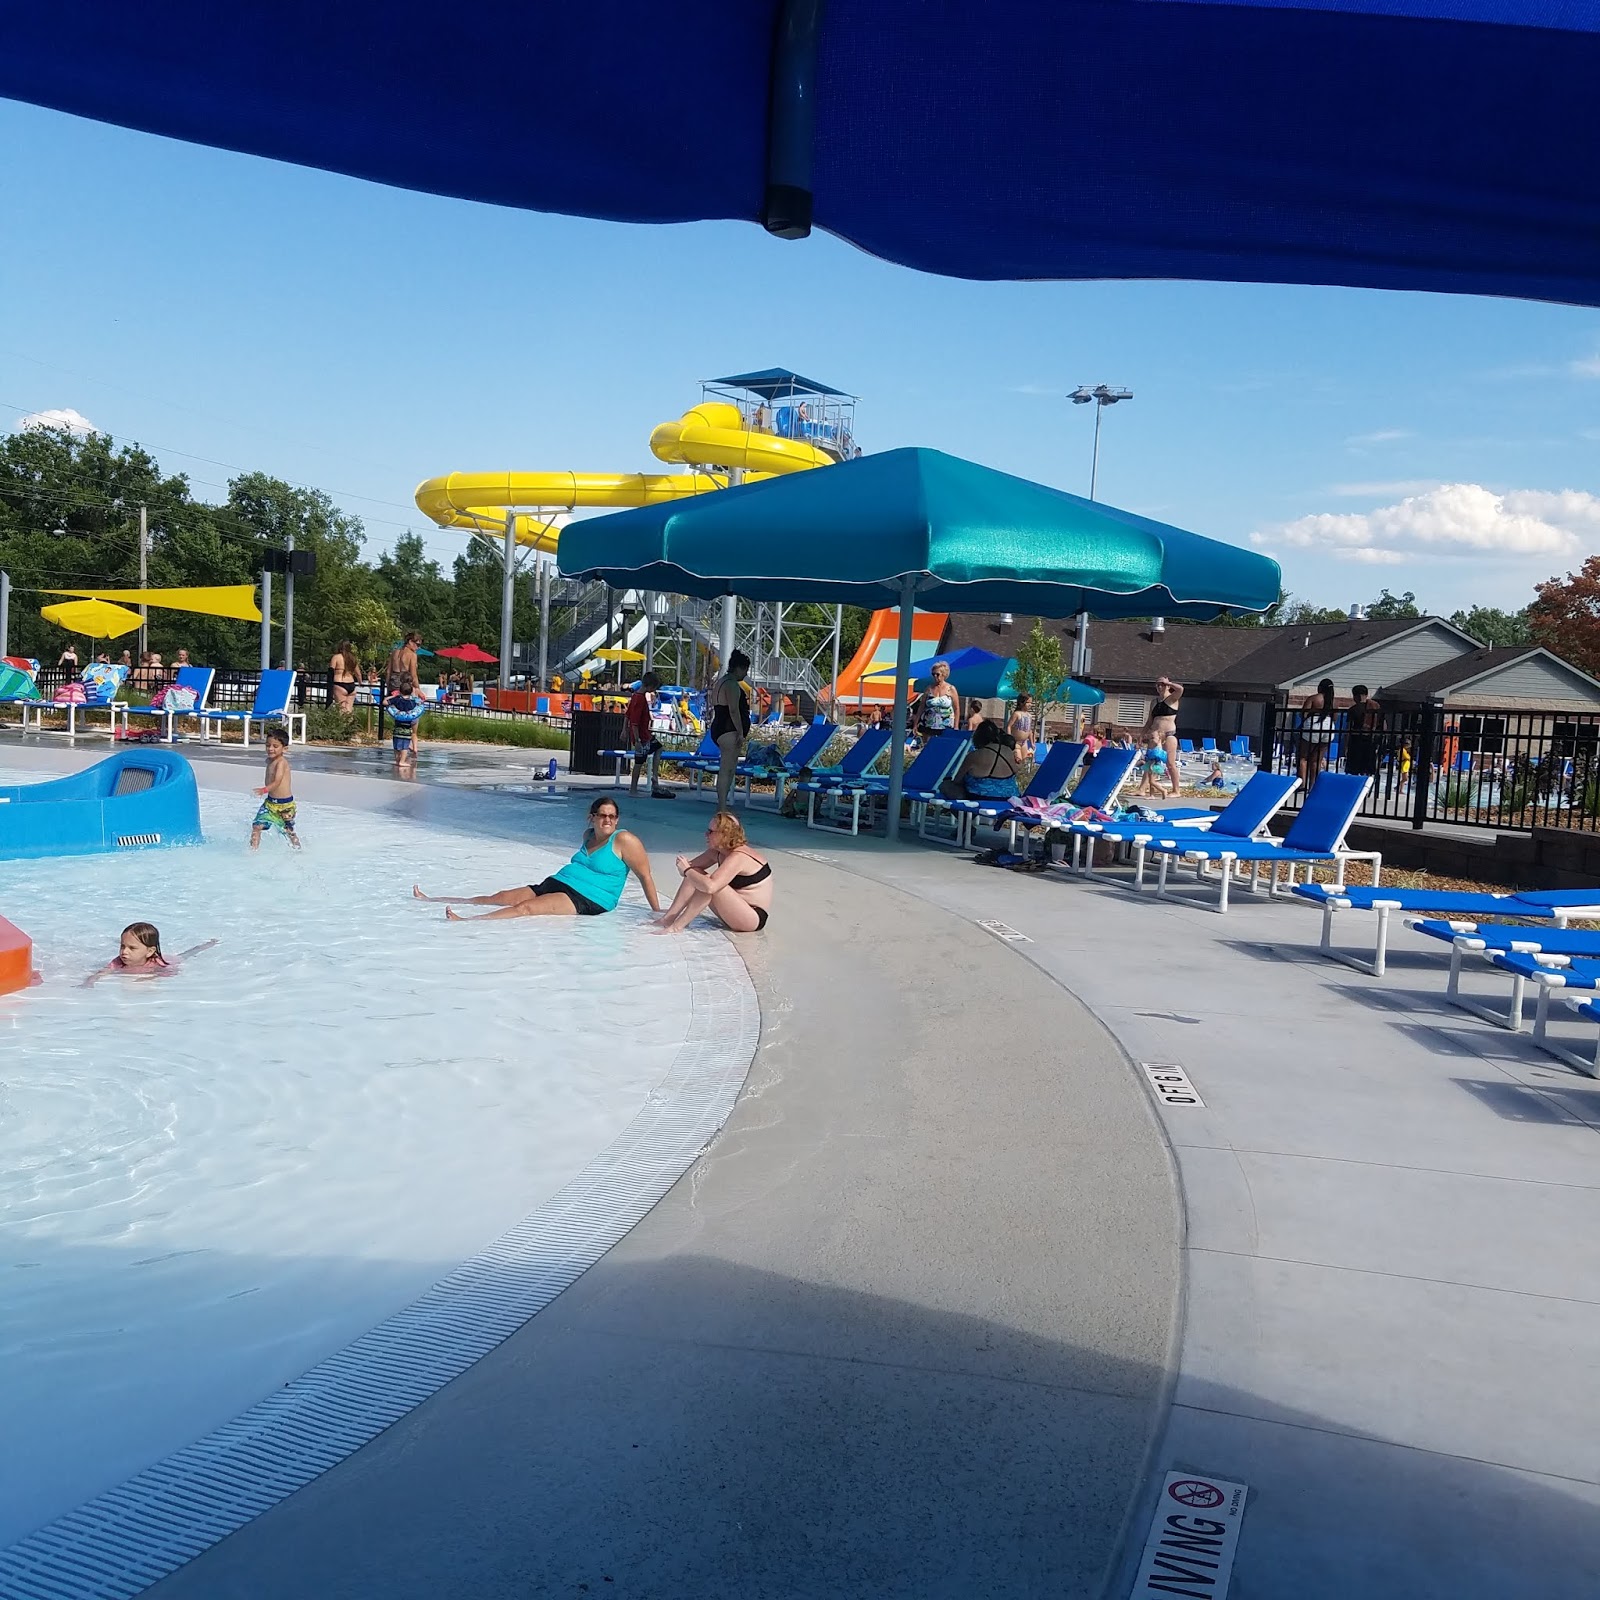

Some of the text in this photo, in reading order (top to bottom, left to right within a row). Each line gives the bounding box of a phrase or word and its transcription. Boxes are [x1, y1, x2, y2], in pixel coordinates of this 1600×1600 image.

[1148, 1064, 1179, 1074] IN
[1158, 1084, 1191, 1094] FT
[1229, 1489, 1242, 1517] NO DIVING
[1147, 1514, 1226, 1600] IVING
